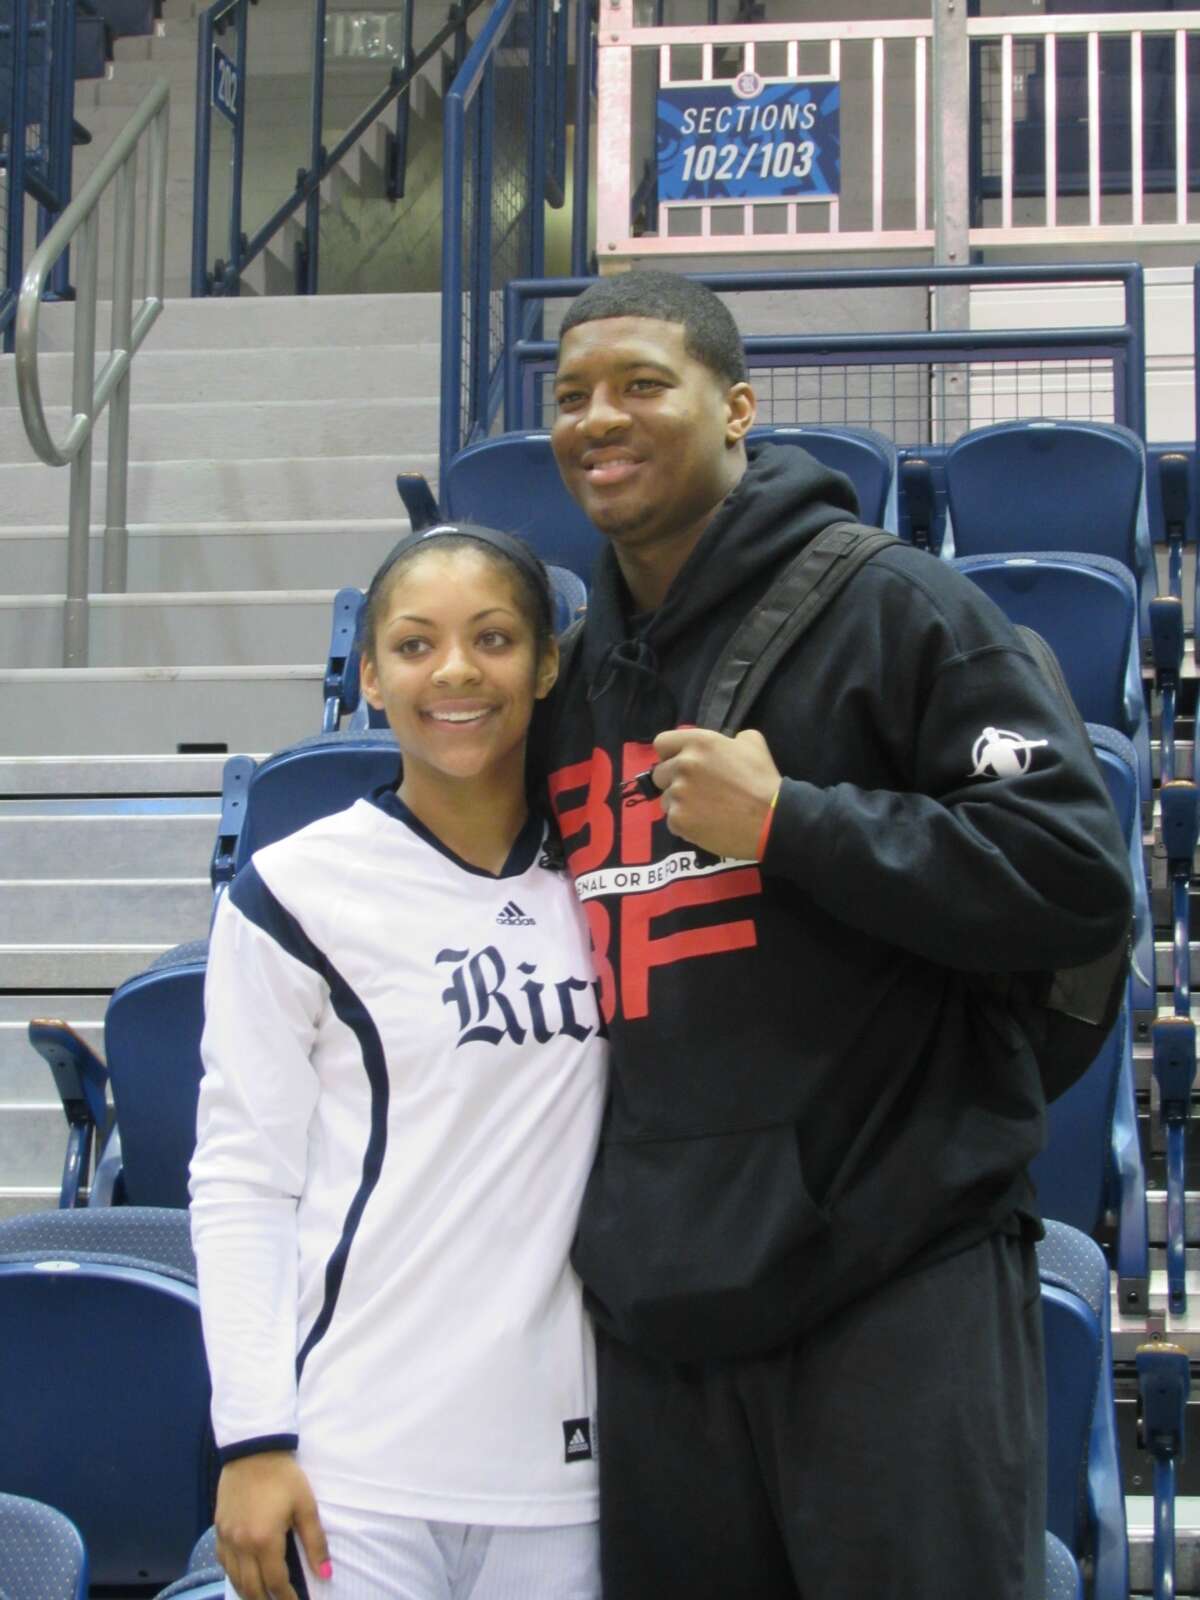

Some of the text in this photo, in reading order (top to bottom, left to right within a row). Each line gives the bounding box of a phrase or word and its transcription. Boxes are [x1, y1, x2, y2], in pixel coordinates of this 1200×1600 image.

[681, 103, 817, 134] SECTIONS
[681, 140, 815, 181] 102/103
[614, 872, 641, 888] OR
[496, 917, 536, 926] adidas
